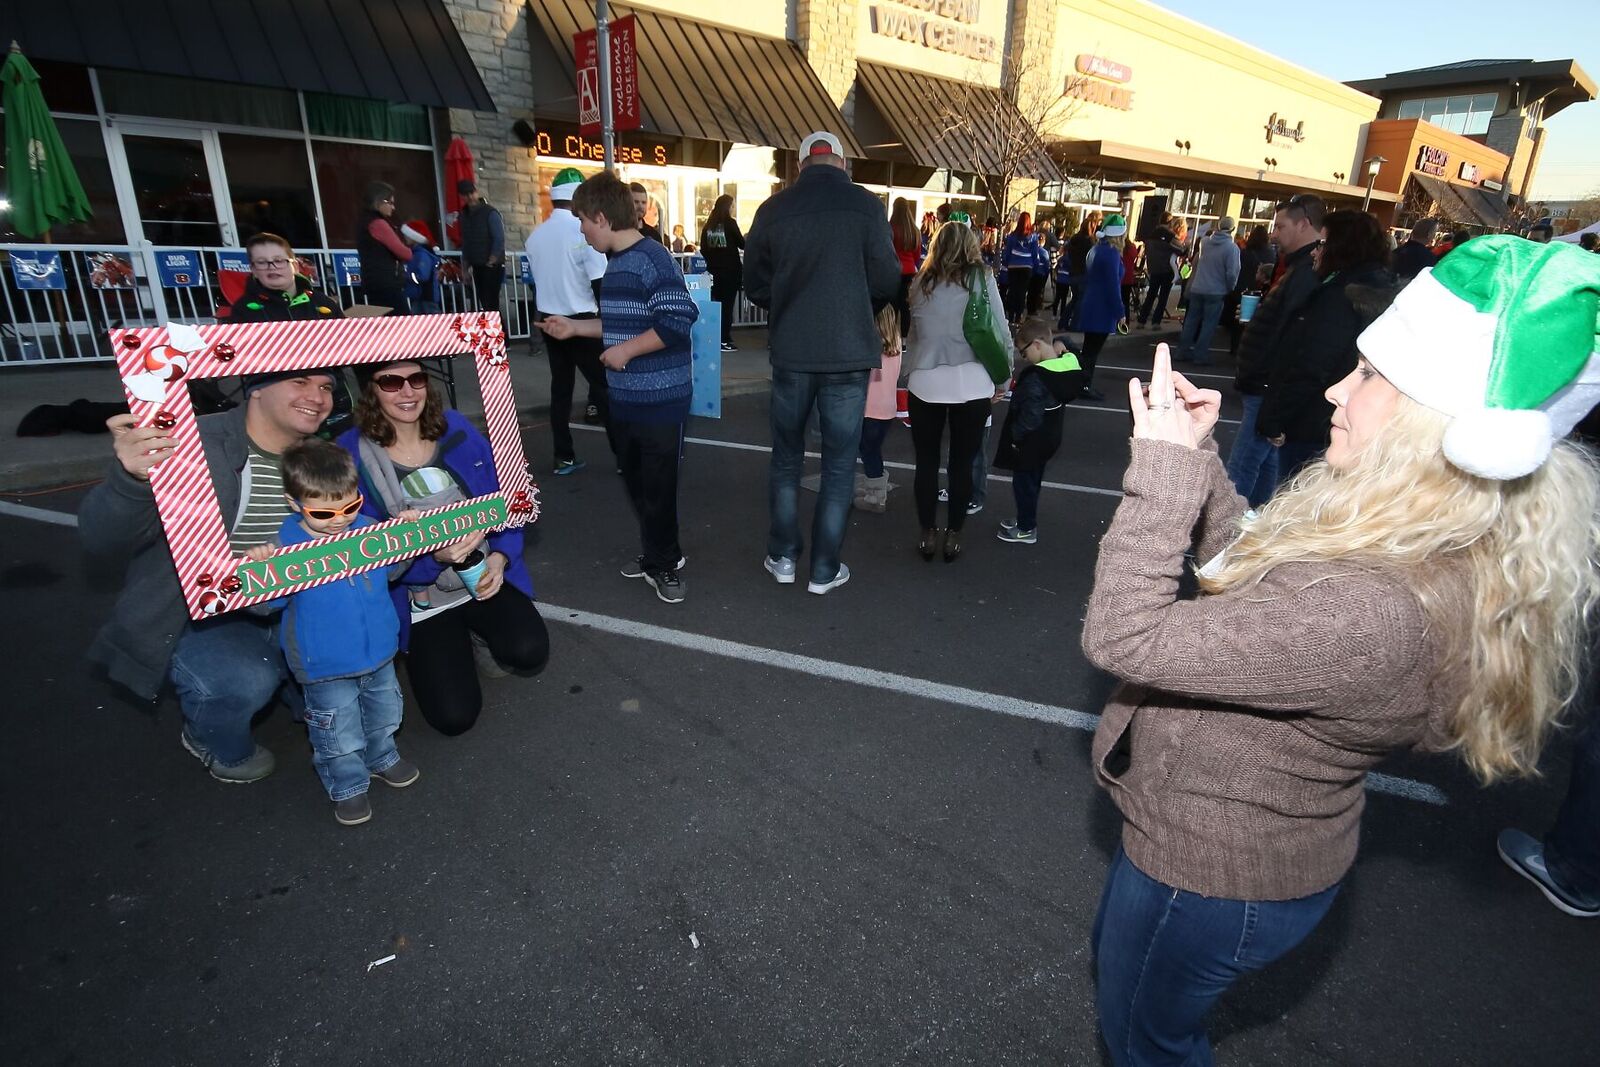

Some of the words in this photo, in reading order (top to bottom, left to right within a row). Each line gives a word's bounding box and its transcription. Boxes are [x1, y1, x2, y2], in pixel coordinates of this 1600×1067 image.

[623, 30, 634, 117] ANDERSON
[869, 5, 926, 46] WAX
[920, 19, 1001, 64] CENTER
[243, 549, 352, 594] Merry
[358, 506, 500, 560] Christmas
